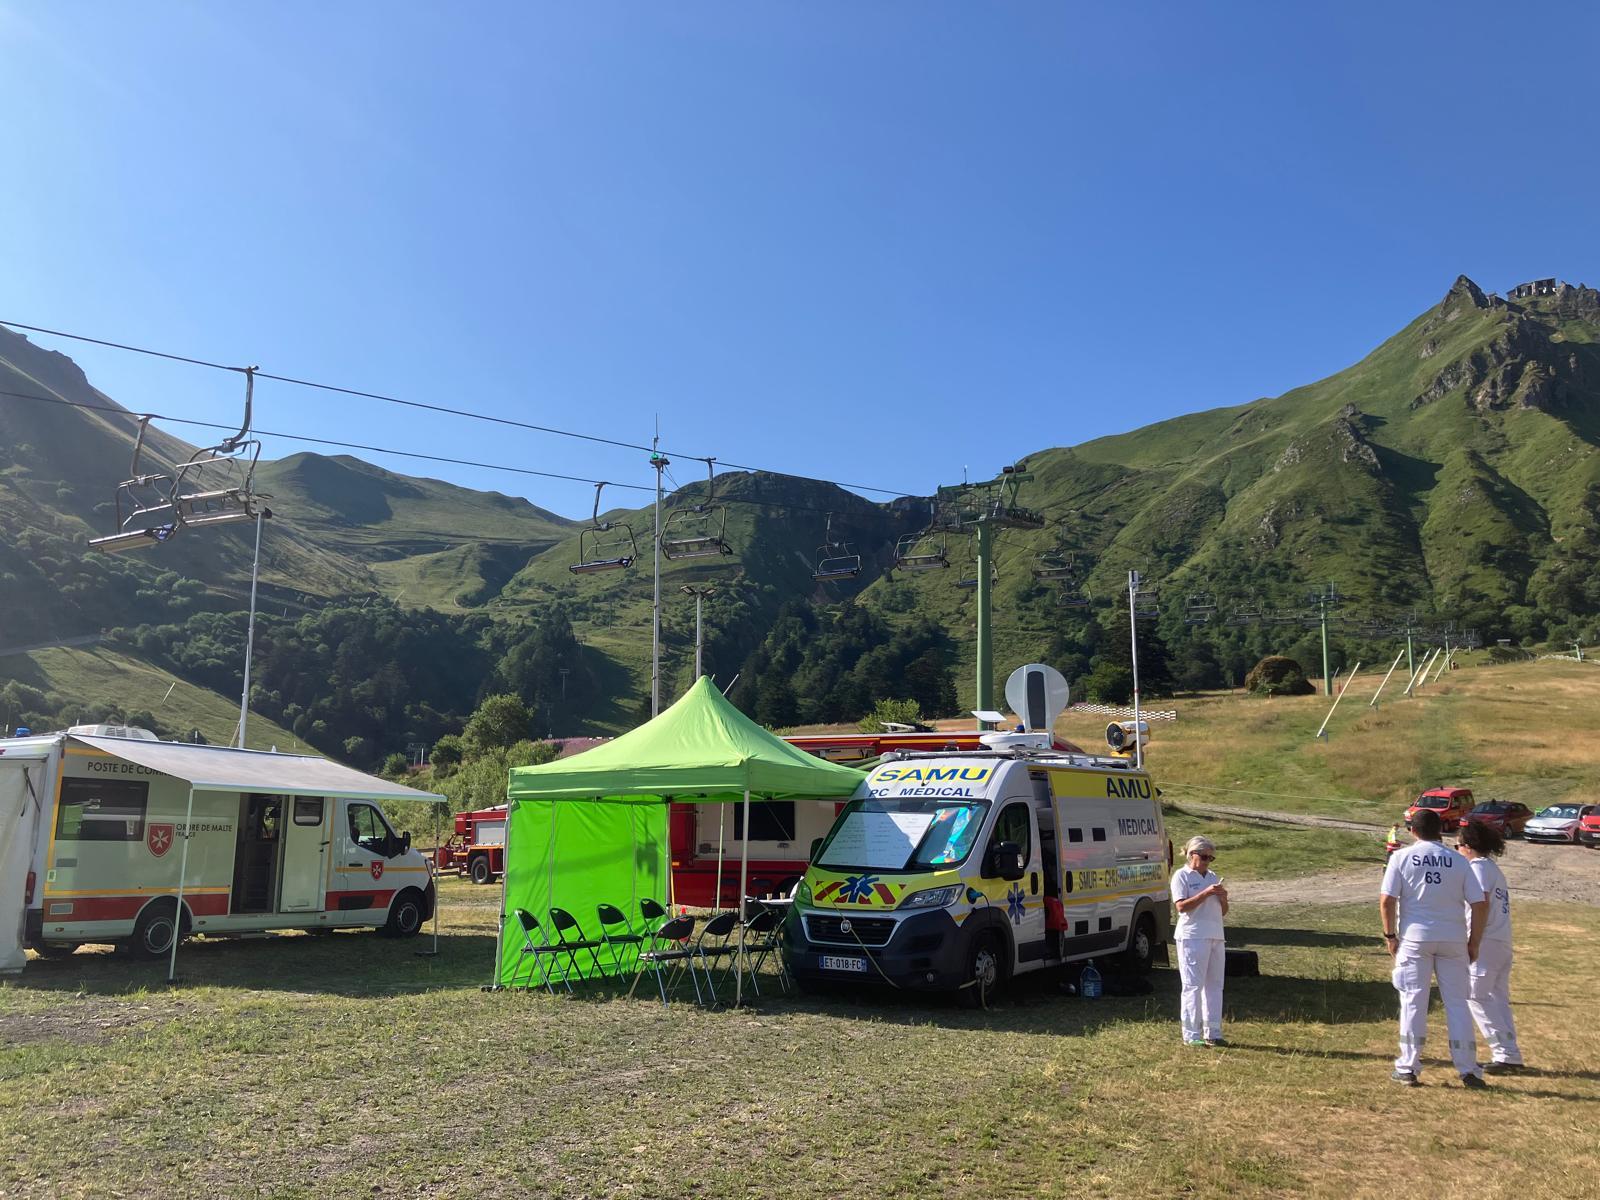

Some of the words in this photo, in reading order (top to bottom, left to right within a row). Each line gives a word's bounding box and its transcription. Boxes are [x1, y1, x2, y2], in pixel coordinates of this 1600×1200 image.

[87, 761, 119, 773] POSTE
[121, 764, 134, 774] DE
[876, 768, 989, 782] SAMU
[899, 787, 974, 797] MEDICAL
[1106, 777, 1151, 799] AMU
[201, 824, 210, 832] DE
[211, 824, 233, 832] MALTE
[1118, 818, 1158, 836] MEDICAL
[1412, 854, 1453, 868] SAMU
[1078, 870, 1098, 890] SMUR
[1425, 871, 1442, 885] 63
[825, 957, 861, 970] ET-018-FC
